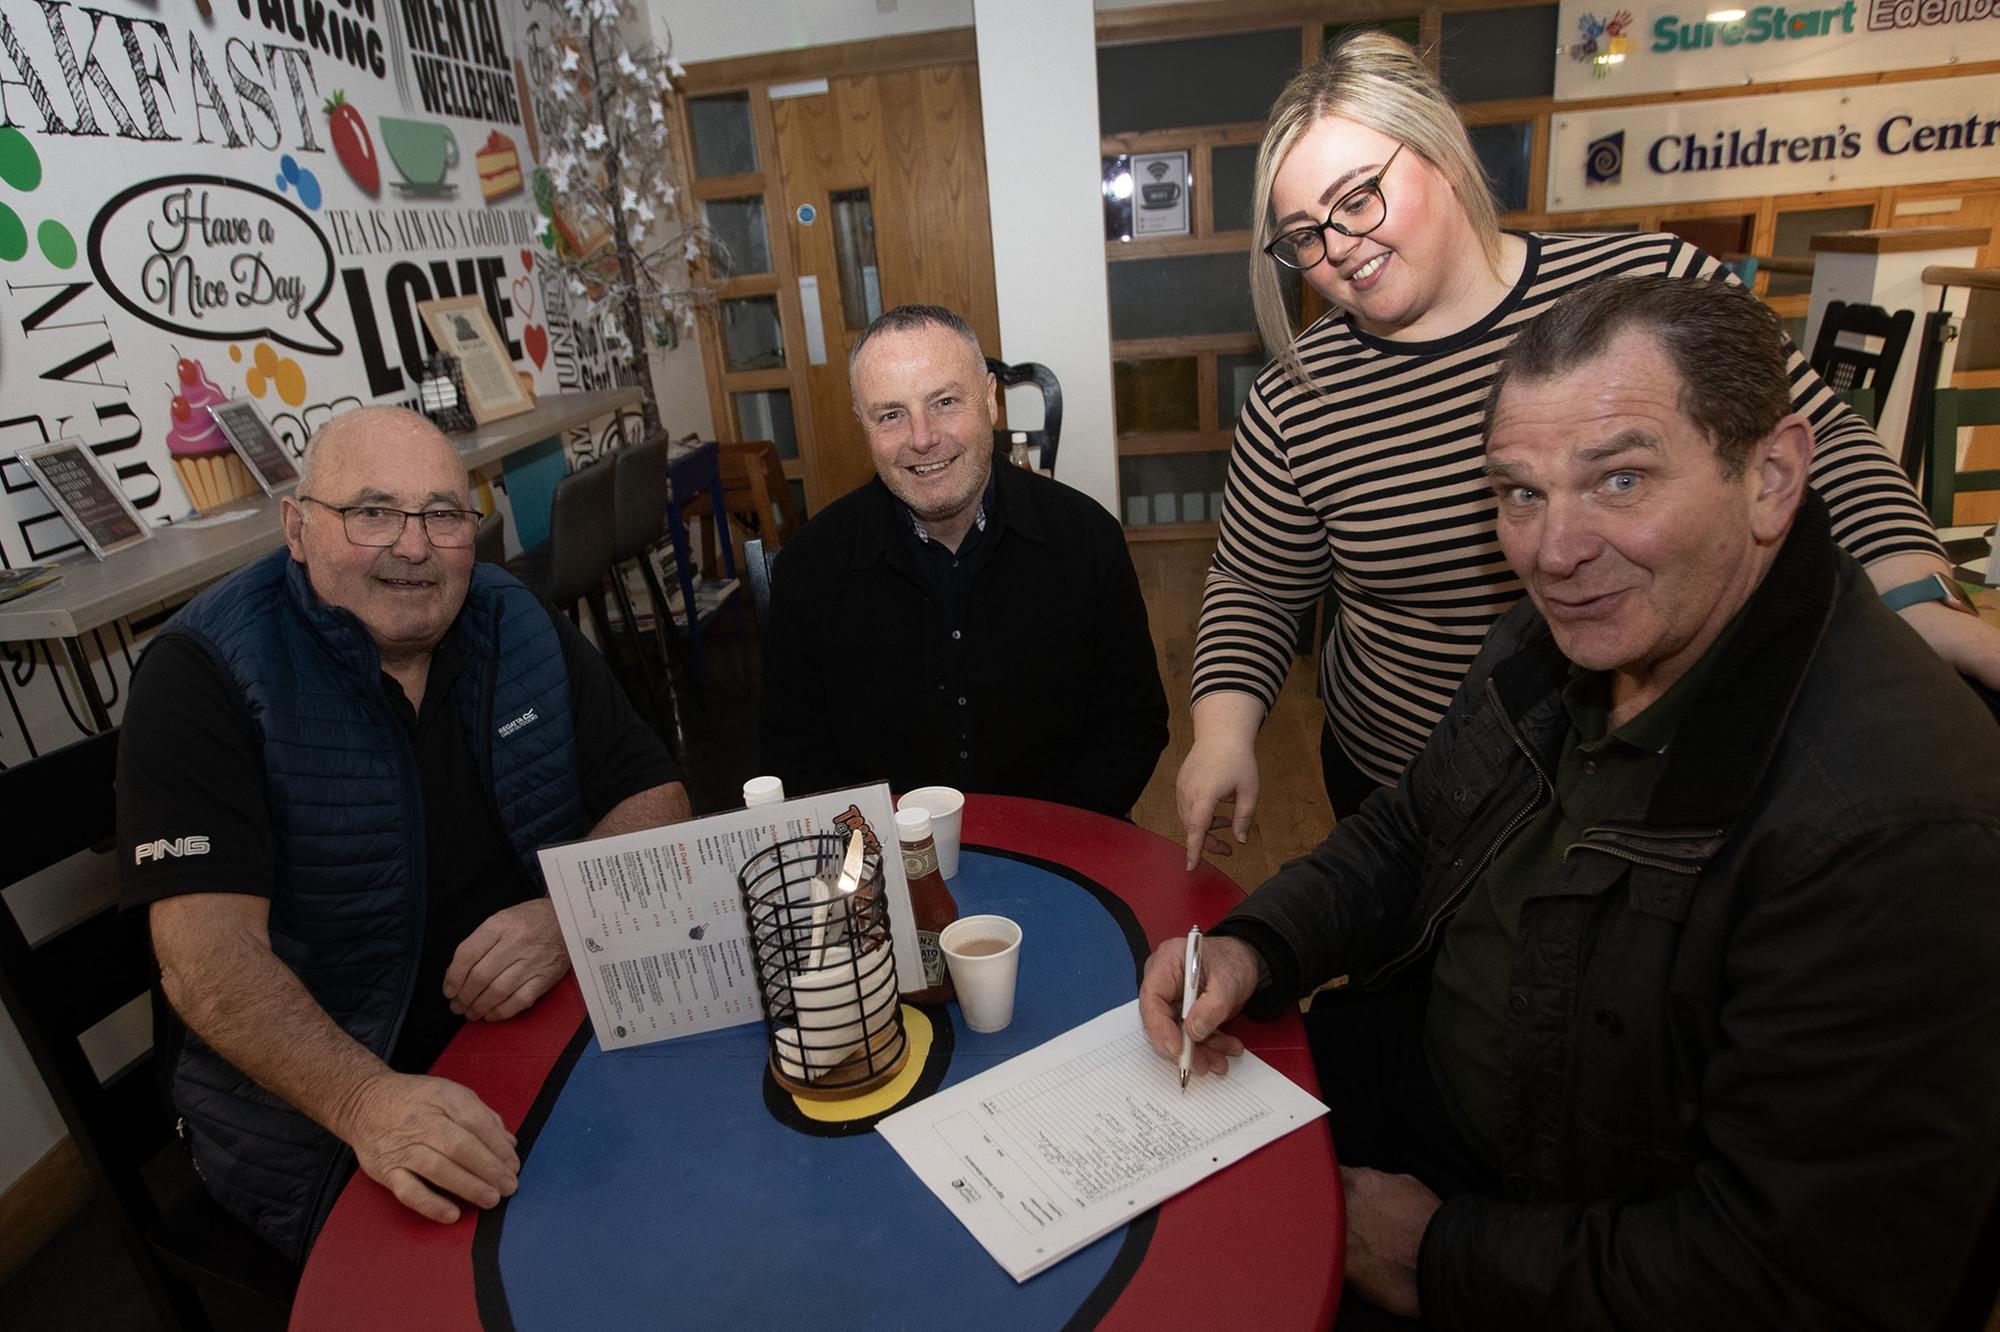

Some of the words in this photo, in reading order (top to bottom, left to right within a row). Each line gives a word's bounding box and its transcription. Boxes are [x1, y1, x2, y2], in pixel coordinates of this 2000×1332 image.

[397, 0, 513, 72] MENTAL
[411, 52, 521, 127] WELLBEING
[1649, 123, 1861, 175] Children's
[147, 187, 252, 256] Have
[257, 216, 275, 245] a
[323, 208, 372, 256] TEA
[367, 208, 393, 254] IS
[393, 208, 457, 251] ALWAYS
[467, 208, 510, 247] GOOD
[141, 253, 228, 319] Nice
[230, 250, 305, 319] Day
[498, 717, 524, 735] REGATTA
[135, 836, 210, 866] PING
[678, 842, 686, 852] All
[680, 852, 688, 865] Day
[683, 865, 693, 885] Menu
